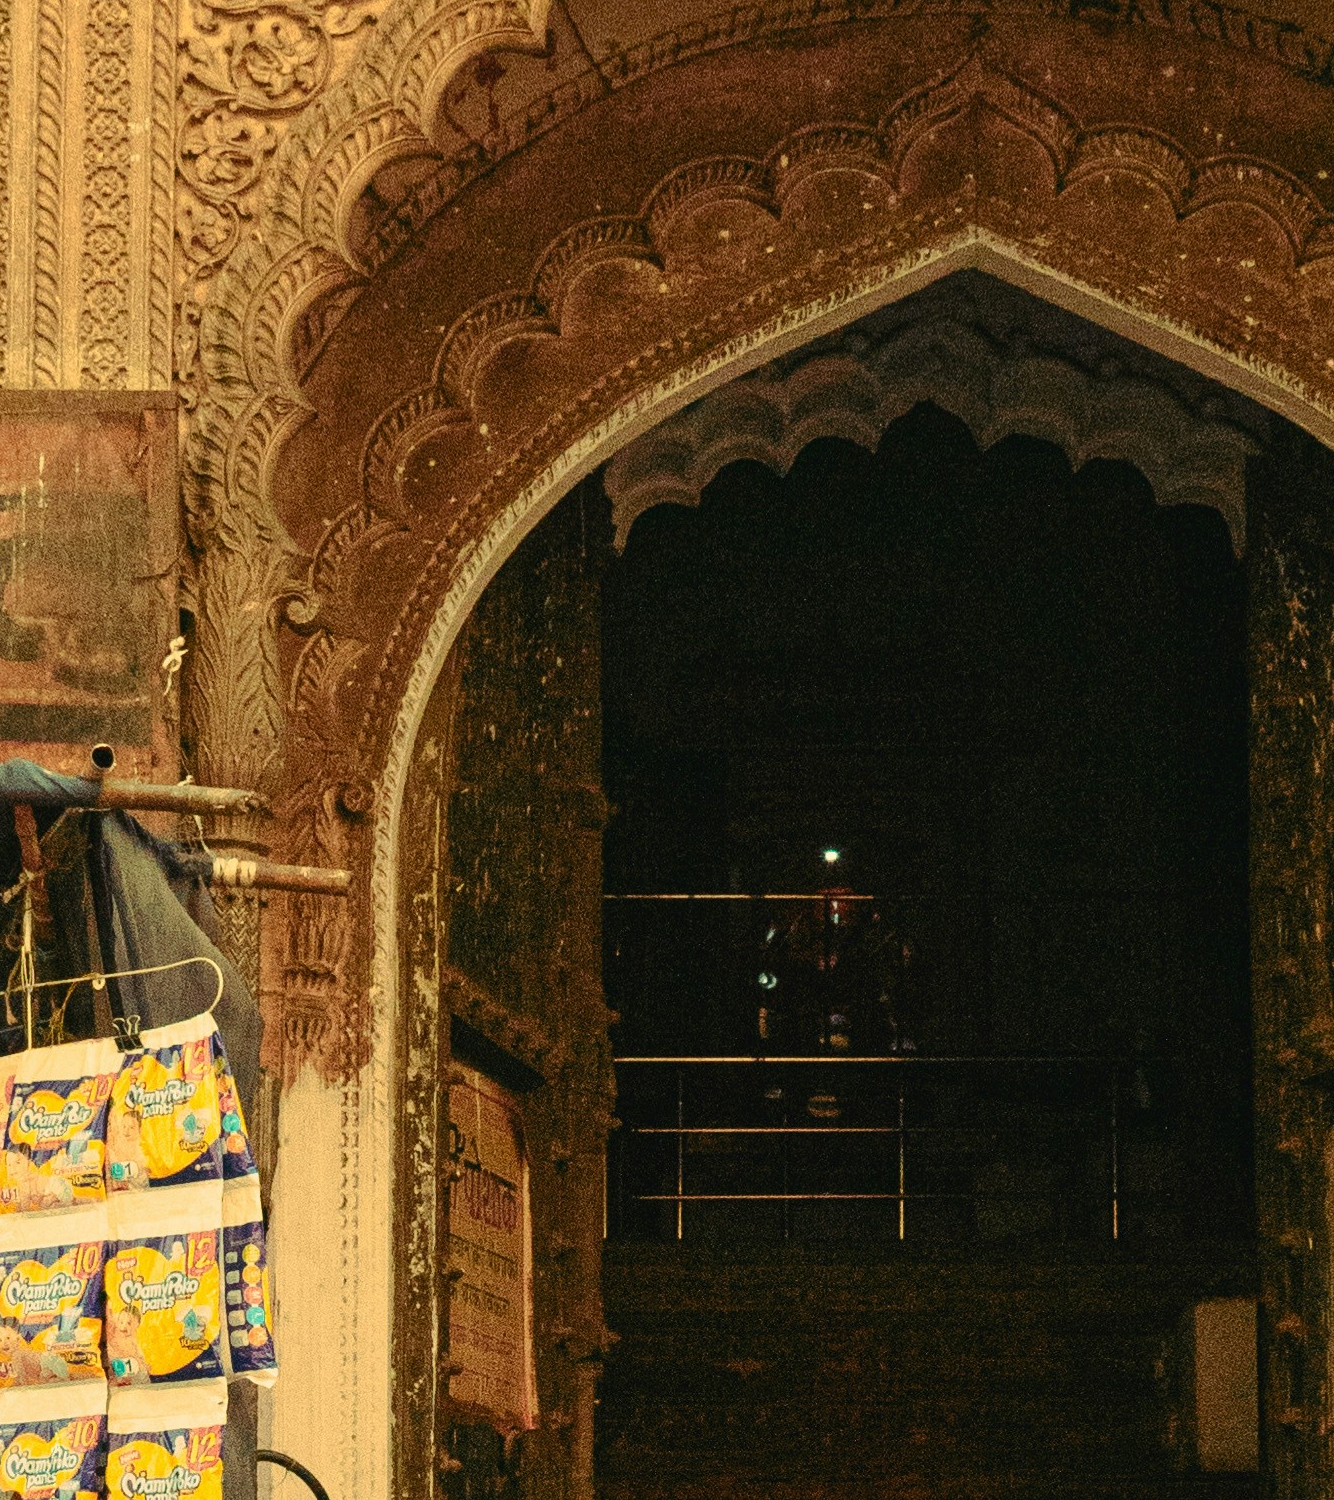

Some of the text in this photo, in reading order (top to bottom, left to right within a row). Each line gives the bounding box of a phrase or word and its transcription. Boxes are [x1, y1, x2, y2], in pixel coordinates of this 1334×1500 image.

[125, 1079, 197, 1109] MamyPoko
[75, 1245, 99, 1275] 10
[187, 1237, 212, 1269] 12
[6, 1272, 83, 1306] MamyPoko
[119, 1271, 200, 1305] MamyPoko
[73, 1420, 99, 1448] 10
[189, 1433, 217, 1464] 12
[121, 1464, 201, 1499] MamyPoko
